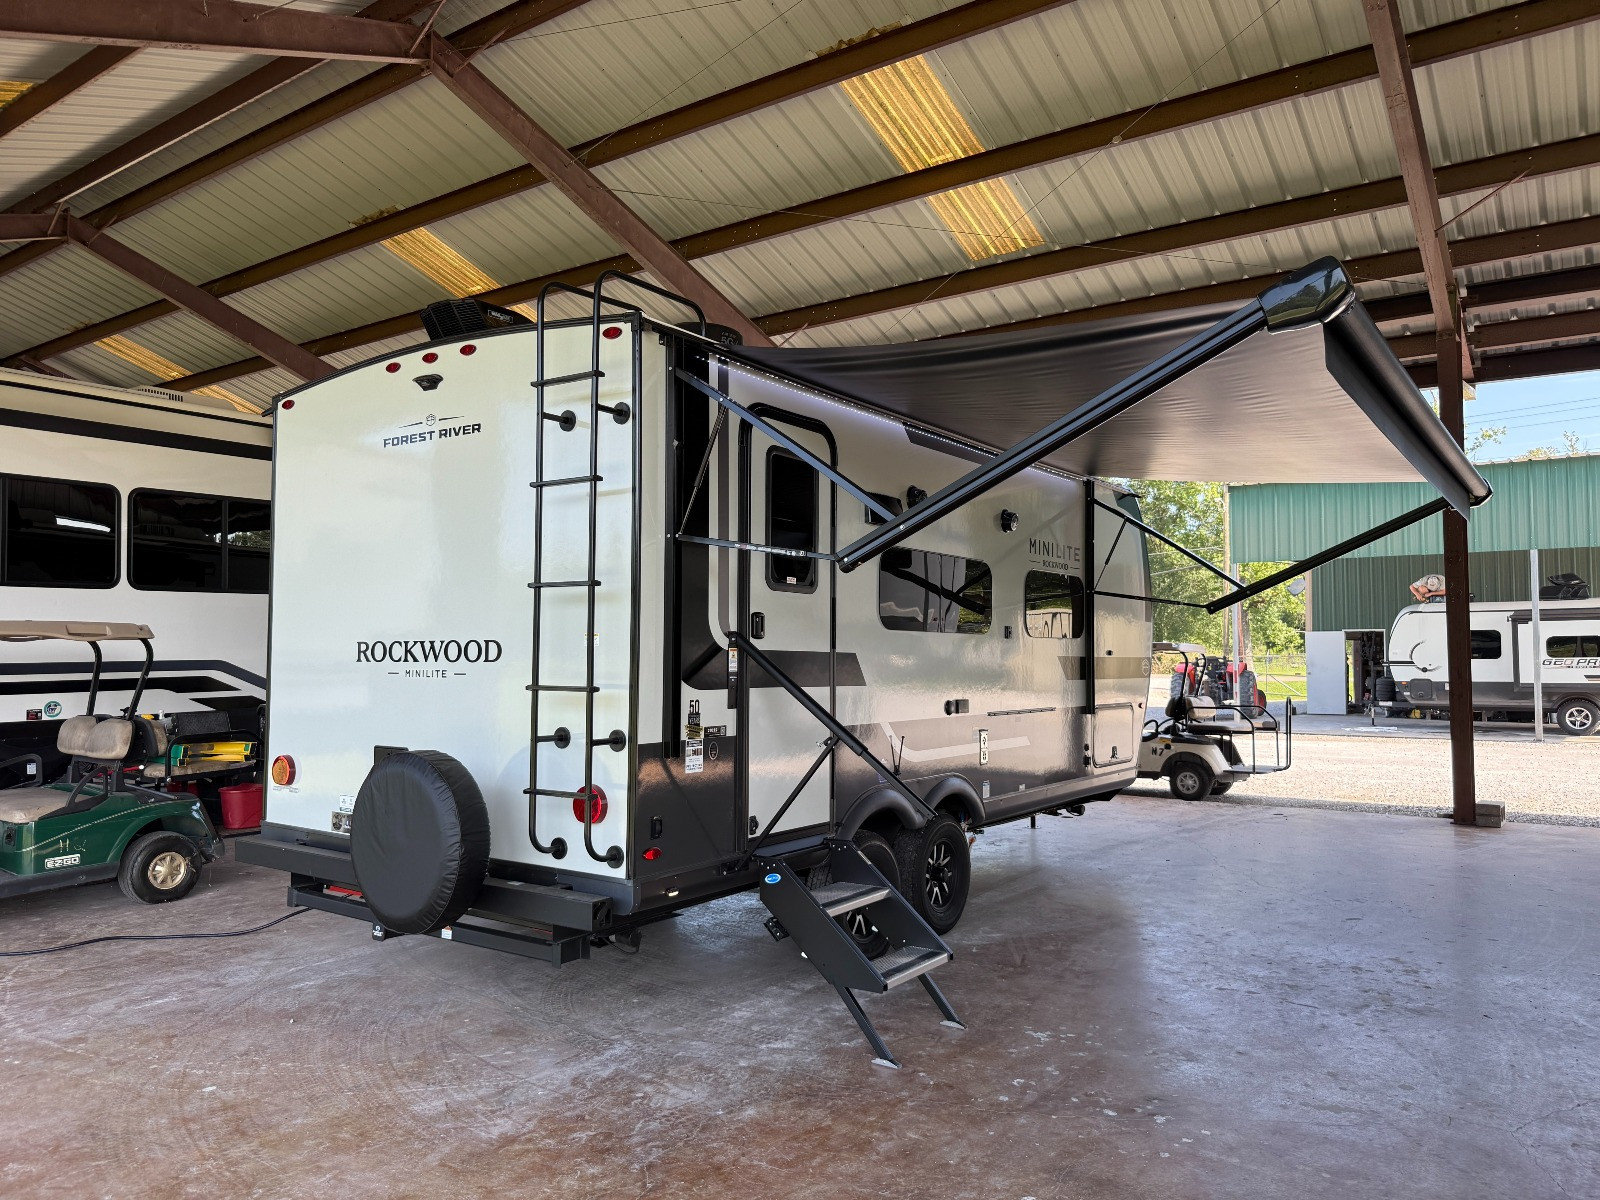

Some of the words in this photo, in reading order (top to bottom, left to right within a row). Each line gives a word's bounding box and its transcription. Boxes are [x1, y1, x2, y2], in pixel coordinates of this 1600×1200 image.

[383, 431, 435, 448] FOREST
[438, 423, 481, 439] RIVER
[1029, 537, 1081, 562] MINILITE
[356, 639, 503, 663] ROCKWOOD
[1542, 658, 1575, 666] GEO
[1576, 658, 1600, 666] PR
[405, 669, 448, 679] MINILITE
[689, 699, 700, 714] 50
